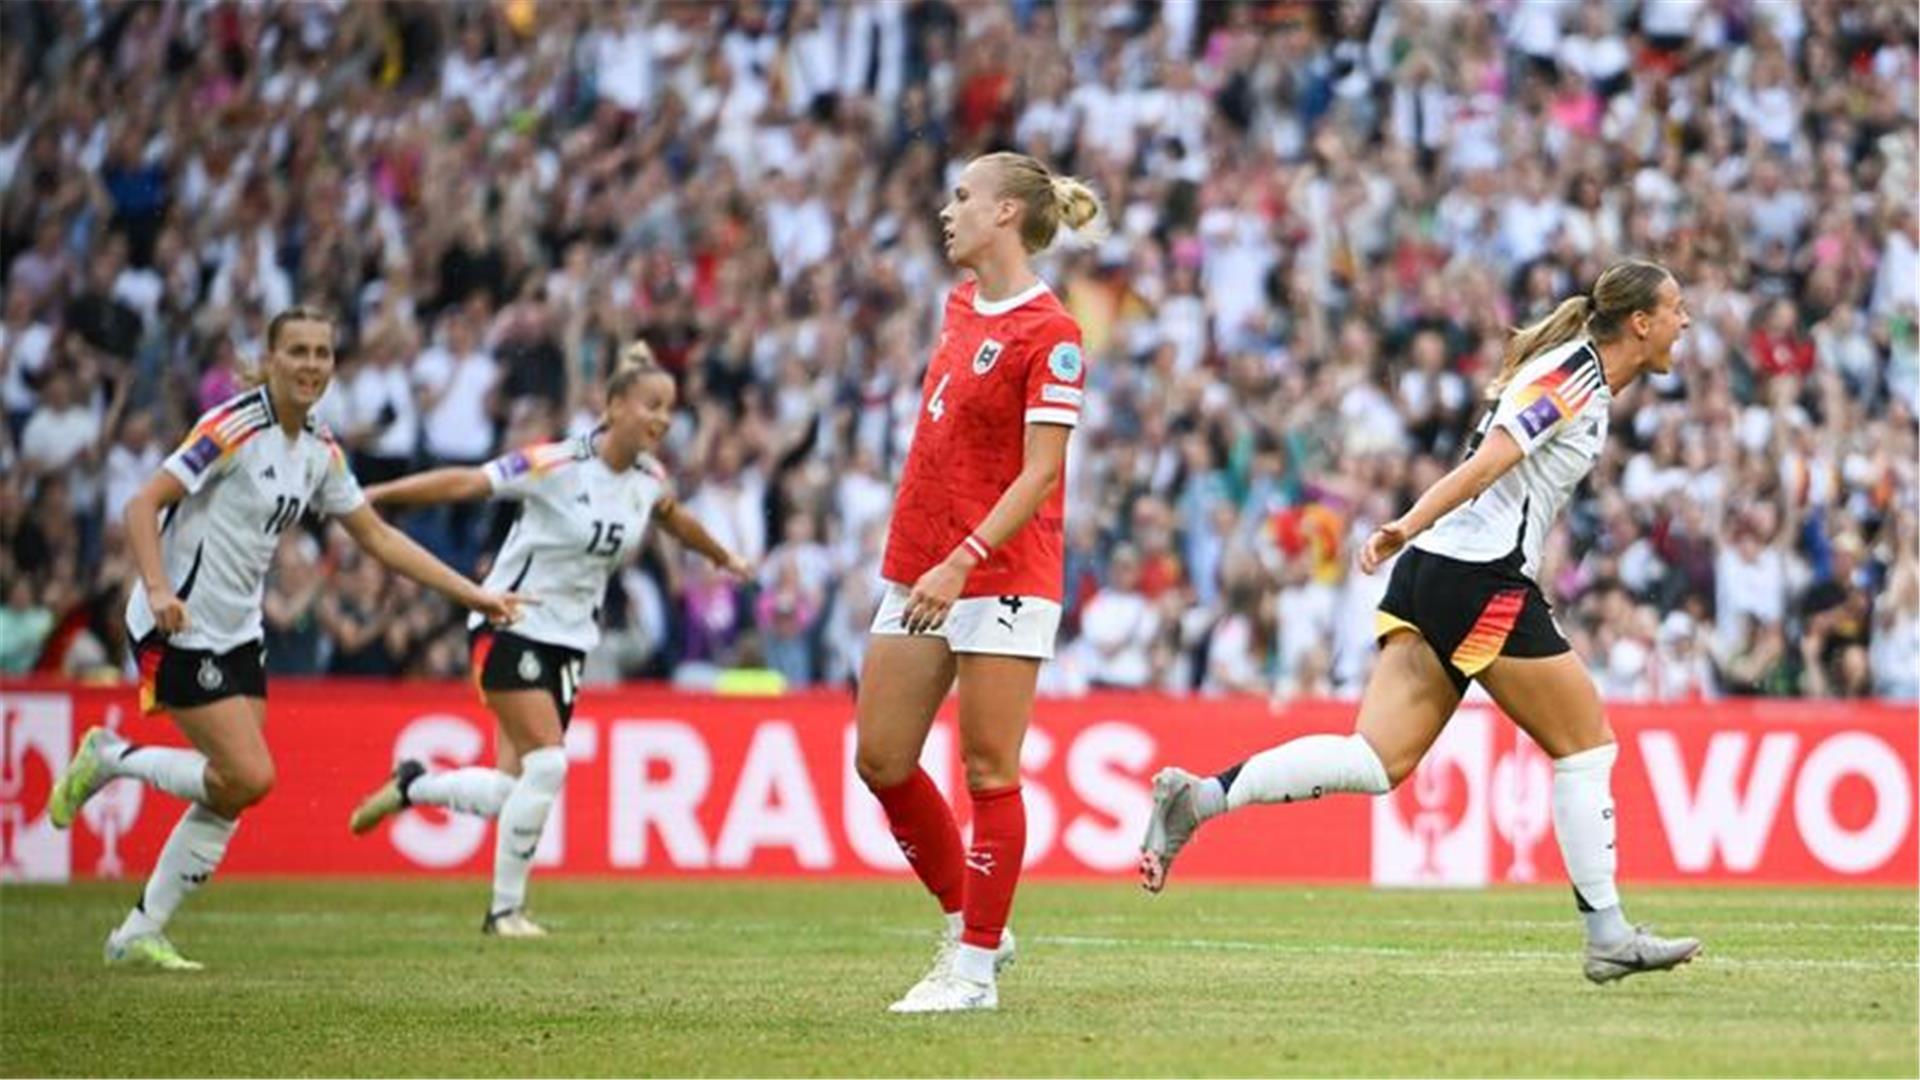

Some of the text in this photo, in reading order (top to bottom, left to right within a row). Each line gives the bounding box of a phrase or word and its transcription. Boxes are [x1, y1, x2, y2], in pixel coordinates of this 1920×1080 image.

[928, 373, 950, 422] 4
[265, 494, 300, 534] 10
[586, 520, 625, 557] 15
[1637, 729, 1913, 875] WO
